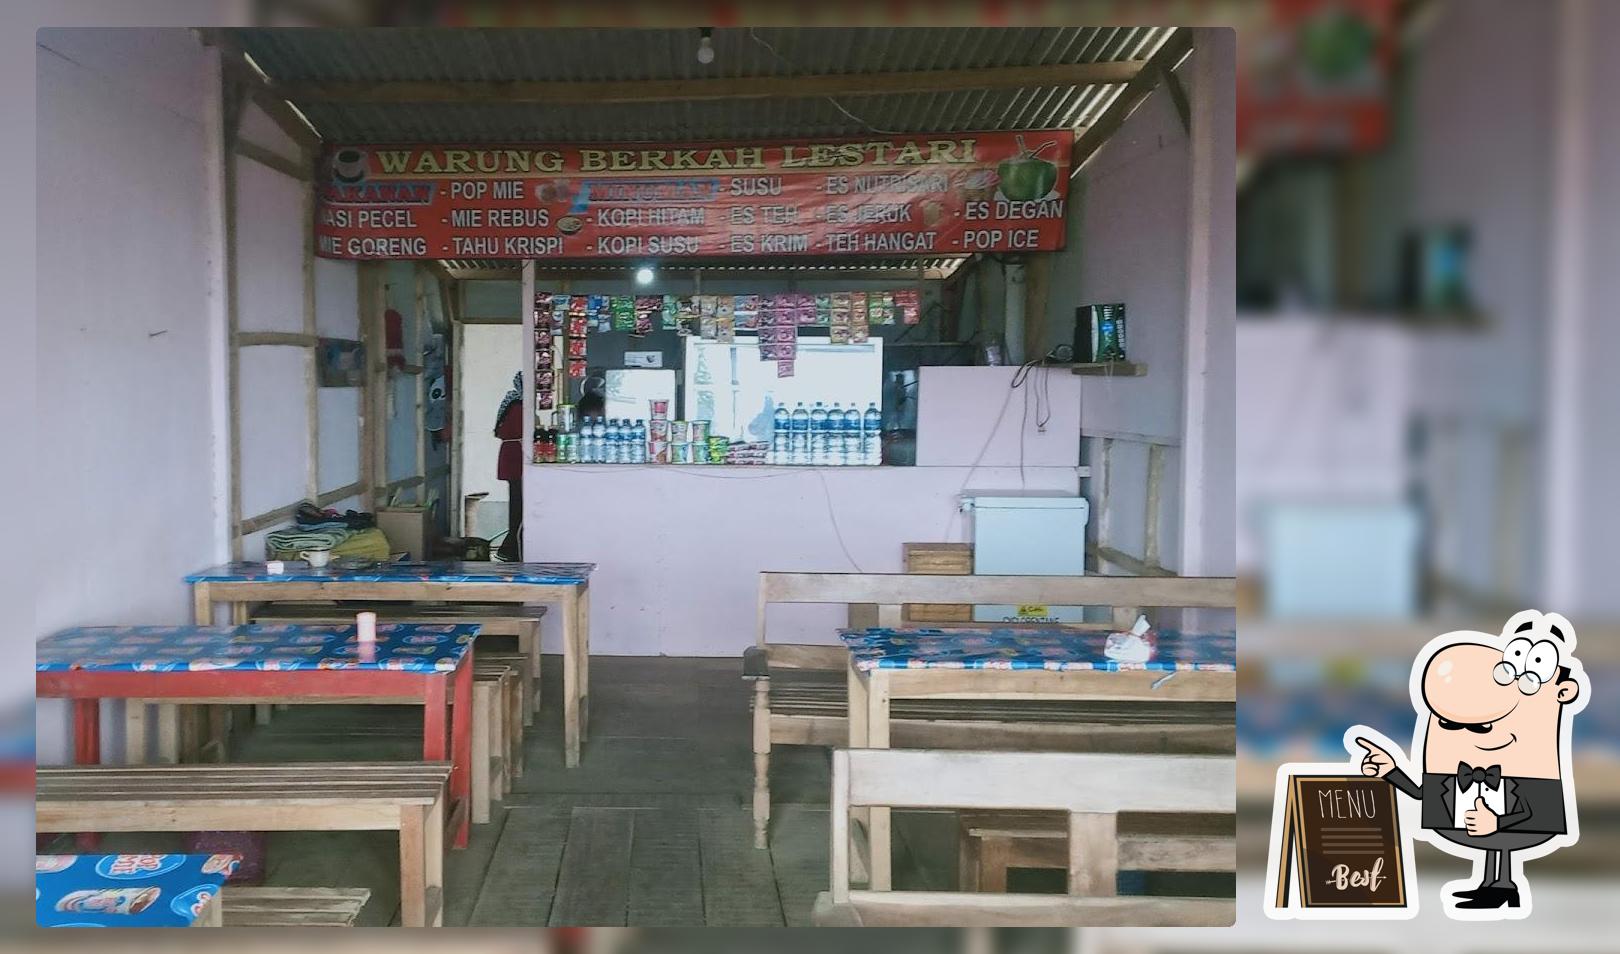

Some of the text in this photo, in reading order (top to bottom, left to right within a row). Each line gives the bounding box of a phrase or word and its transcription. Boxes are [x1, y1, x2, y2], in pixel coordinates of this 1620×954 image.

[377, 139, 977, 174] WARUNG BERKAH LESTARI
[450, 181, 524, 200] POP MIE
[731, 176, 782, 196] SUSU
[826, 176, 849, 195] ES
[358, 209, 417, 228] PECEL
[451, 208, 549, 228] MIE REBUS
[597, 206, 705, 227] KOPI HITAM
[731, 205, 799, 225] ES TEH
[826, 203, 912, 223] ES JERUK
[965, 200, 1063, 220] ES DEGAN
[347, 237, 426, 255] GORENG
[452, 236, 564, 255] TAHU KRISPI
[597, 235, 699, 254] KOPI SUSU
[731, 233, 808, 253] ES KRIM
[825, 231, 937, 252] TEH HANGAT
[963, 229, 1039, 249] POP ICE
